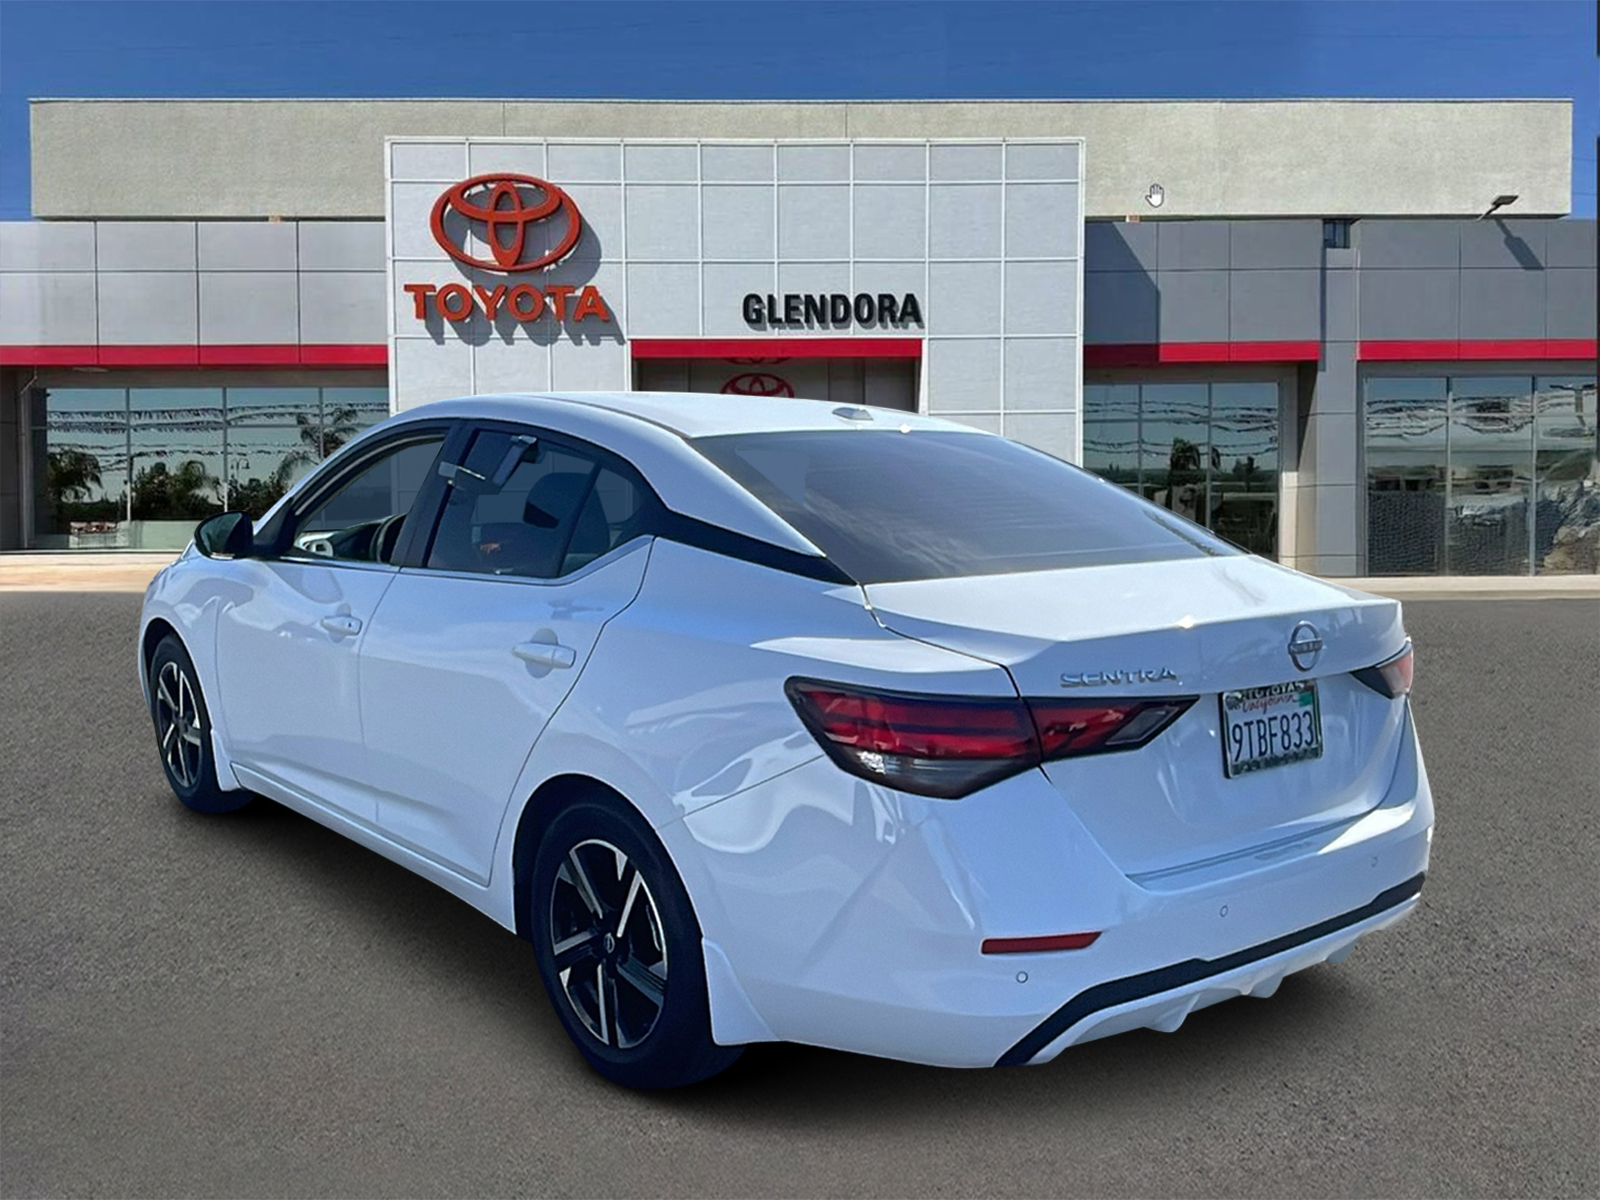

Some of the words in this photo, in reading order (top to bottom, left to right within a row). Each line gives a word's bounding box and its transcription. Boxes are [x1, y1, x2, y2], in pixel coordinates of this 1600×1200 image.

[404, 283, 610, 322] TOYOTA
[743, 293, 922, 325] GLENDORA
[1060, 667, 1177, 688] SENTRA
[1232, 710, 1315, 763] 9TBF833
